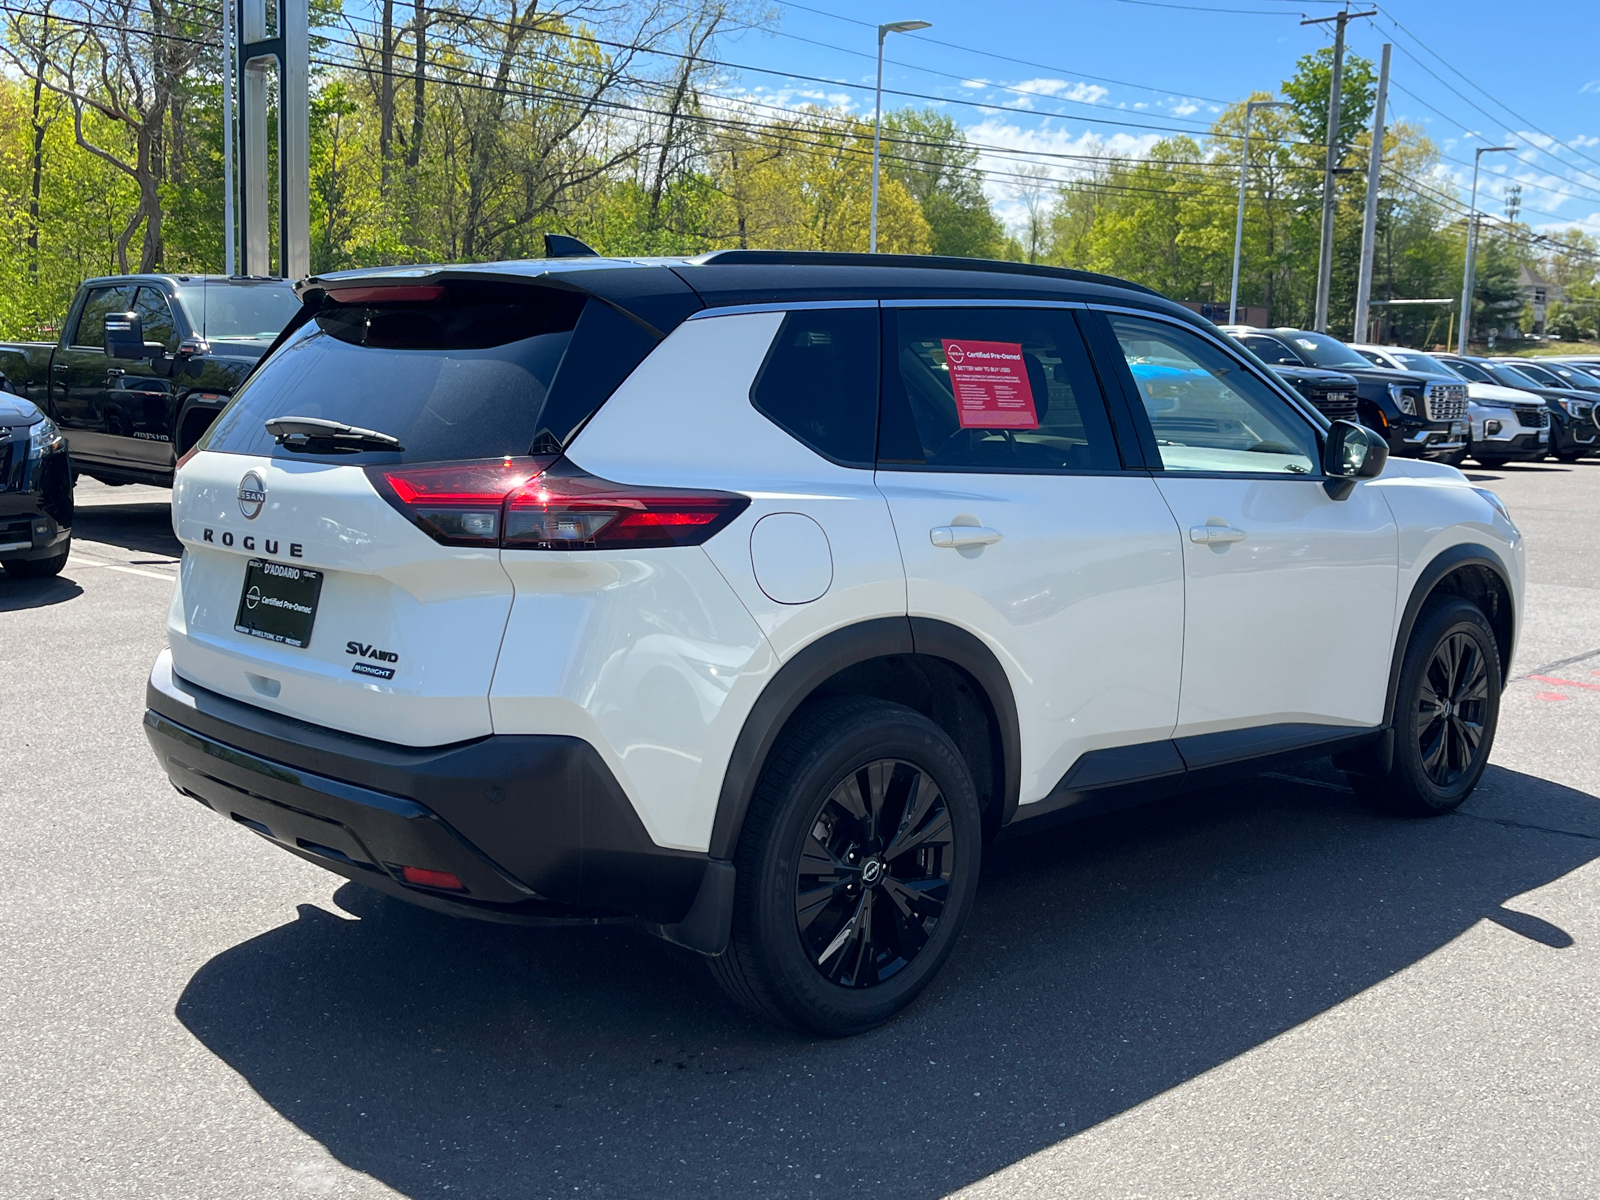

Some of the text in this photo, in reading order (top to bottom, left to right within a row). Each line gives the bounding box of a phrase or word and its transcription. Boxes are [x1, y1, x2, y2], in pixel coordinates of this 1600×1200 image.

[966, 351, 1021, 361] Certified Pre-Owned
[239, 490, 264, 501] SSAN
[203, 528, 304, 558] ROGUE
[264, 563, 300, 580] D'ADDARIO
[261, 596, 312, 614] Certified Pre-Owned
[345, 640, 399, 663] SV AWD
[354, 664, 391, 677] MIDNIGHT
